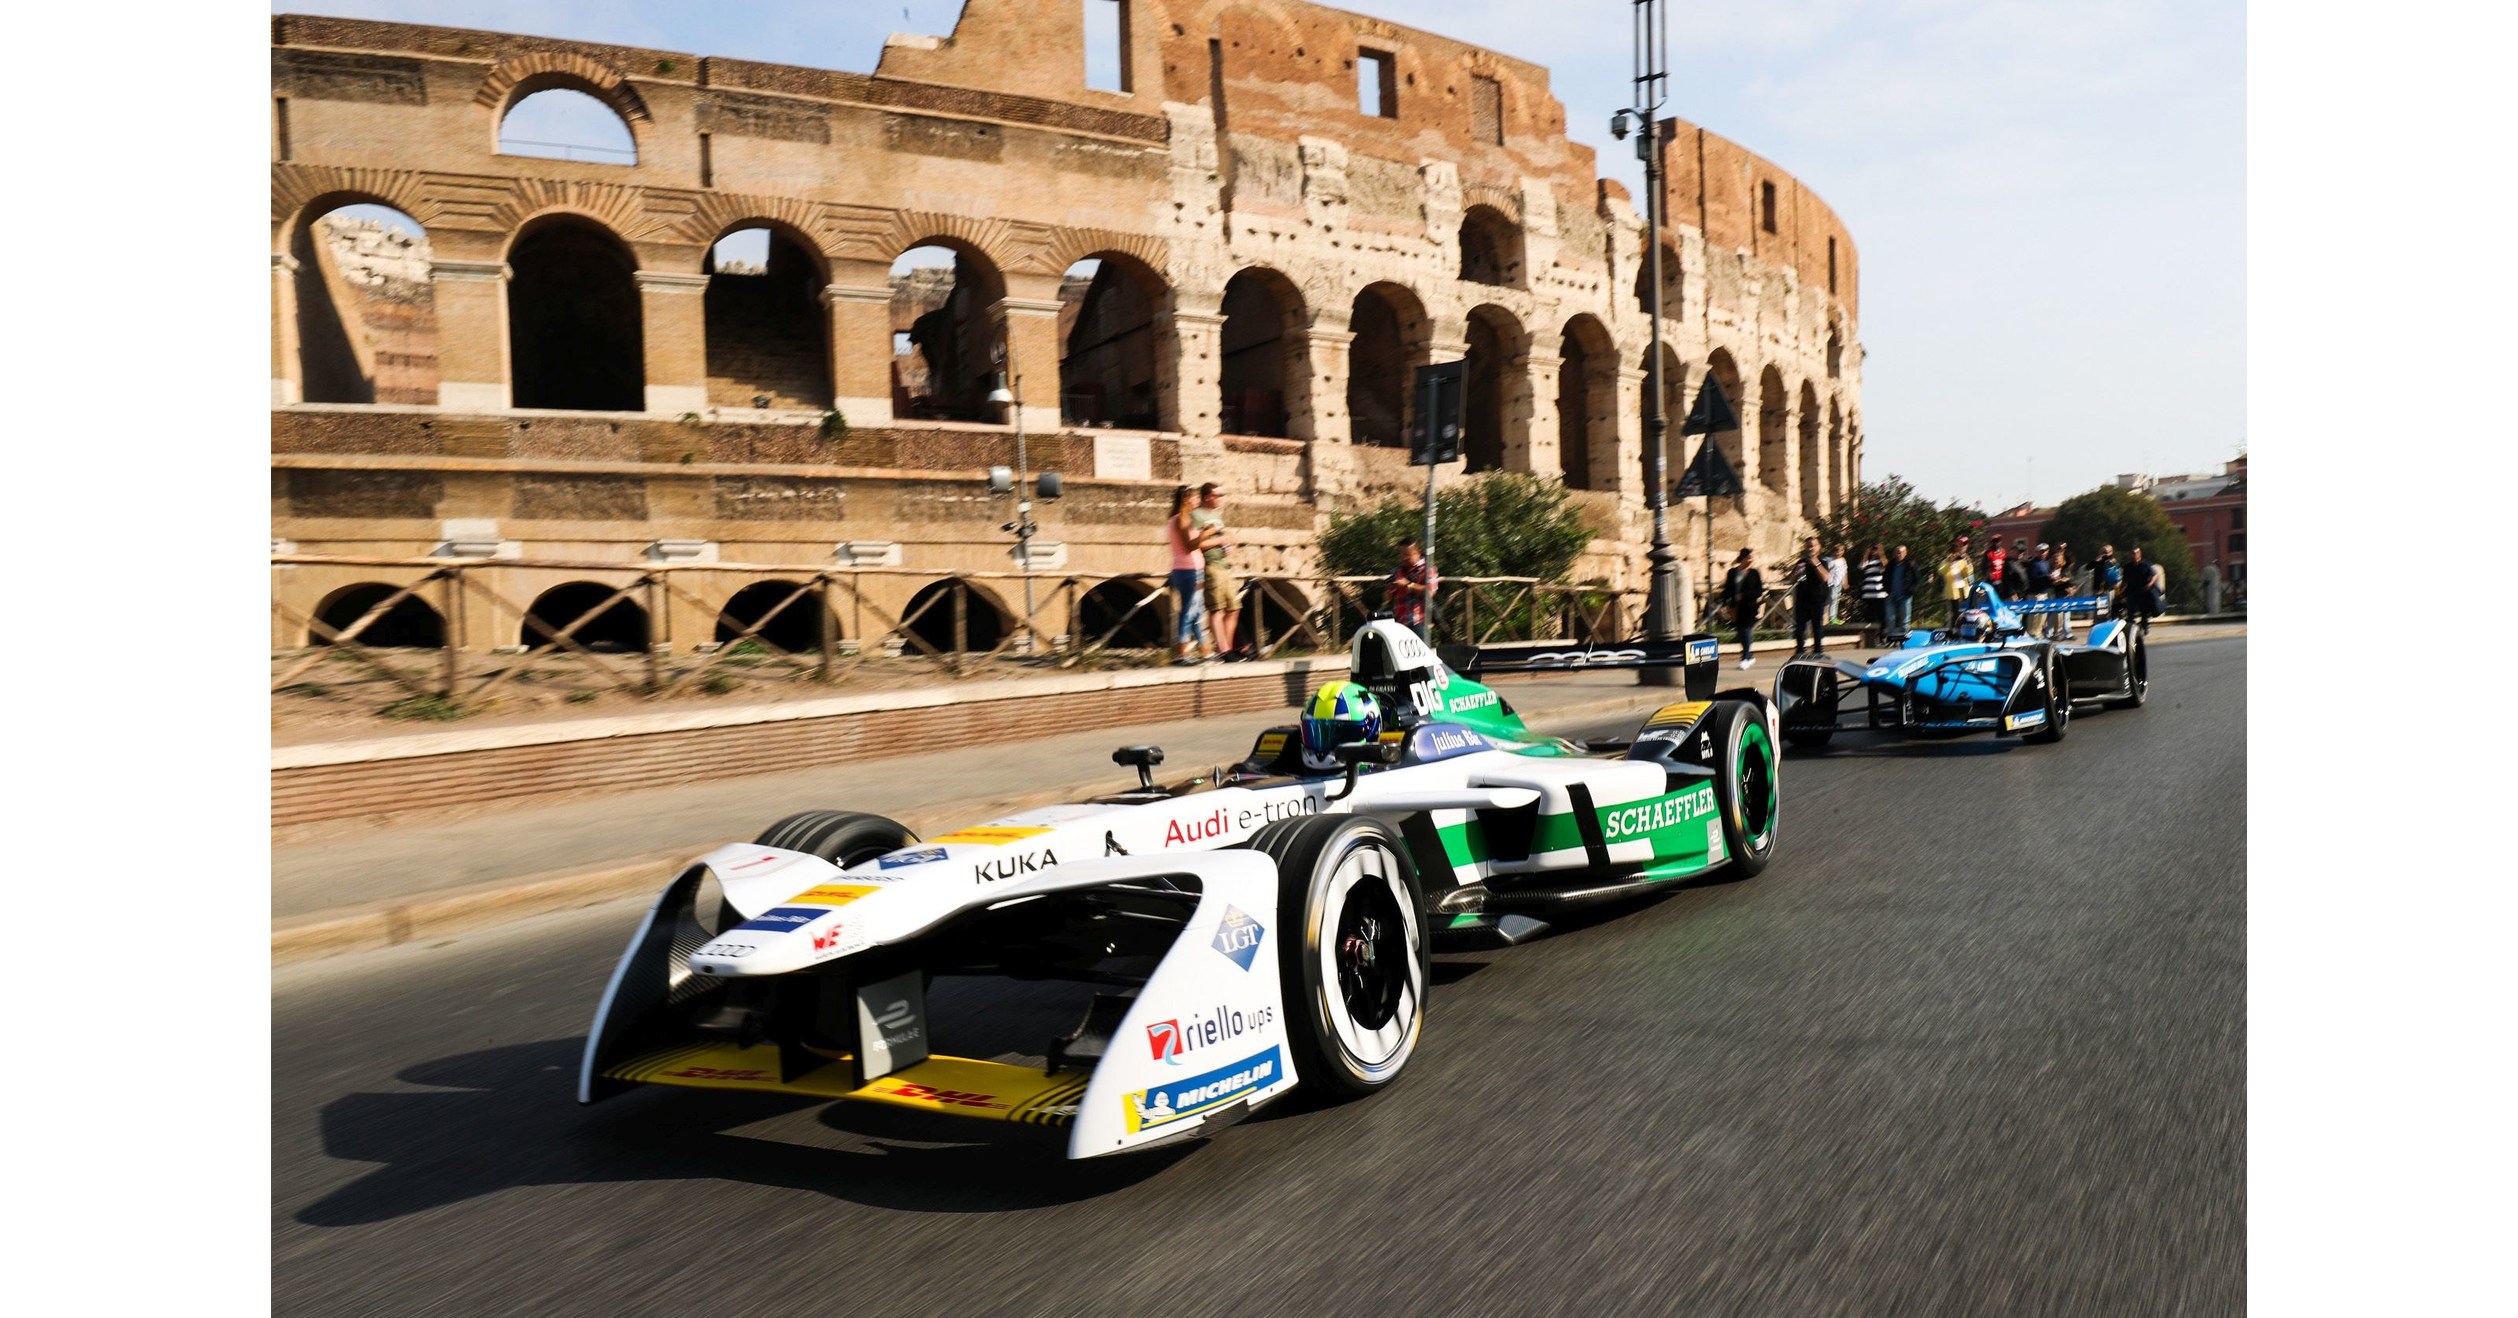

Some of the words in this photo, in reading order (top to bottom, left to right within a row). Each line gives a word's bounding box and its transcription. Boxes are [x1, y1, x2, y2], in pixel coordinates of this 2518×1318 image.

[1409, 679, 1445, 717] DIG
[1448, 689, 1498, 714] SCHAEFFLER
[1431, 731, 1466, 756] Julius
[1164, 807, 1229, 848] Audi
[1238, 794, 1318, 830] e-tron
[1605, 785, 1716, 840] SCHAEFFLER
[975, 848, 1059, 885] KUKA
[1217, 923, 1260, 954] LGT
[1186, 1004, 1244, 1052] riello
[1247, 1006, 1274, 1034] ups
[889, 1084, 1000, 1107] DHL
[1175, 1060, 1274, 1109] MICHELIN
